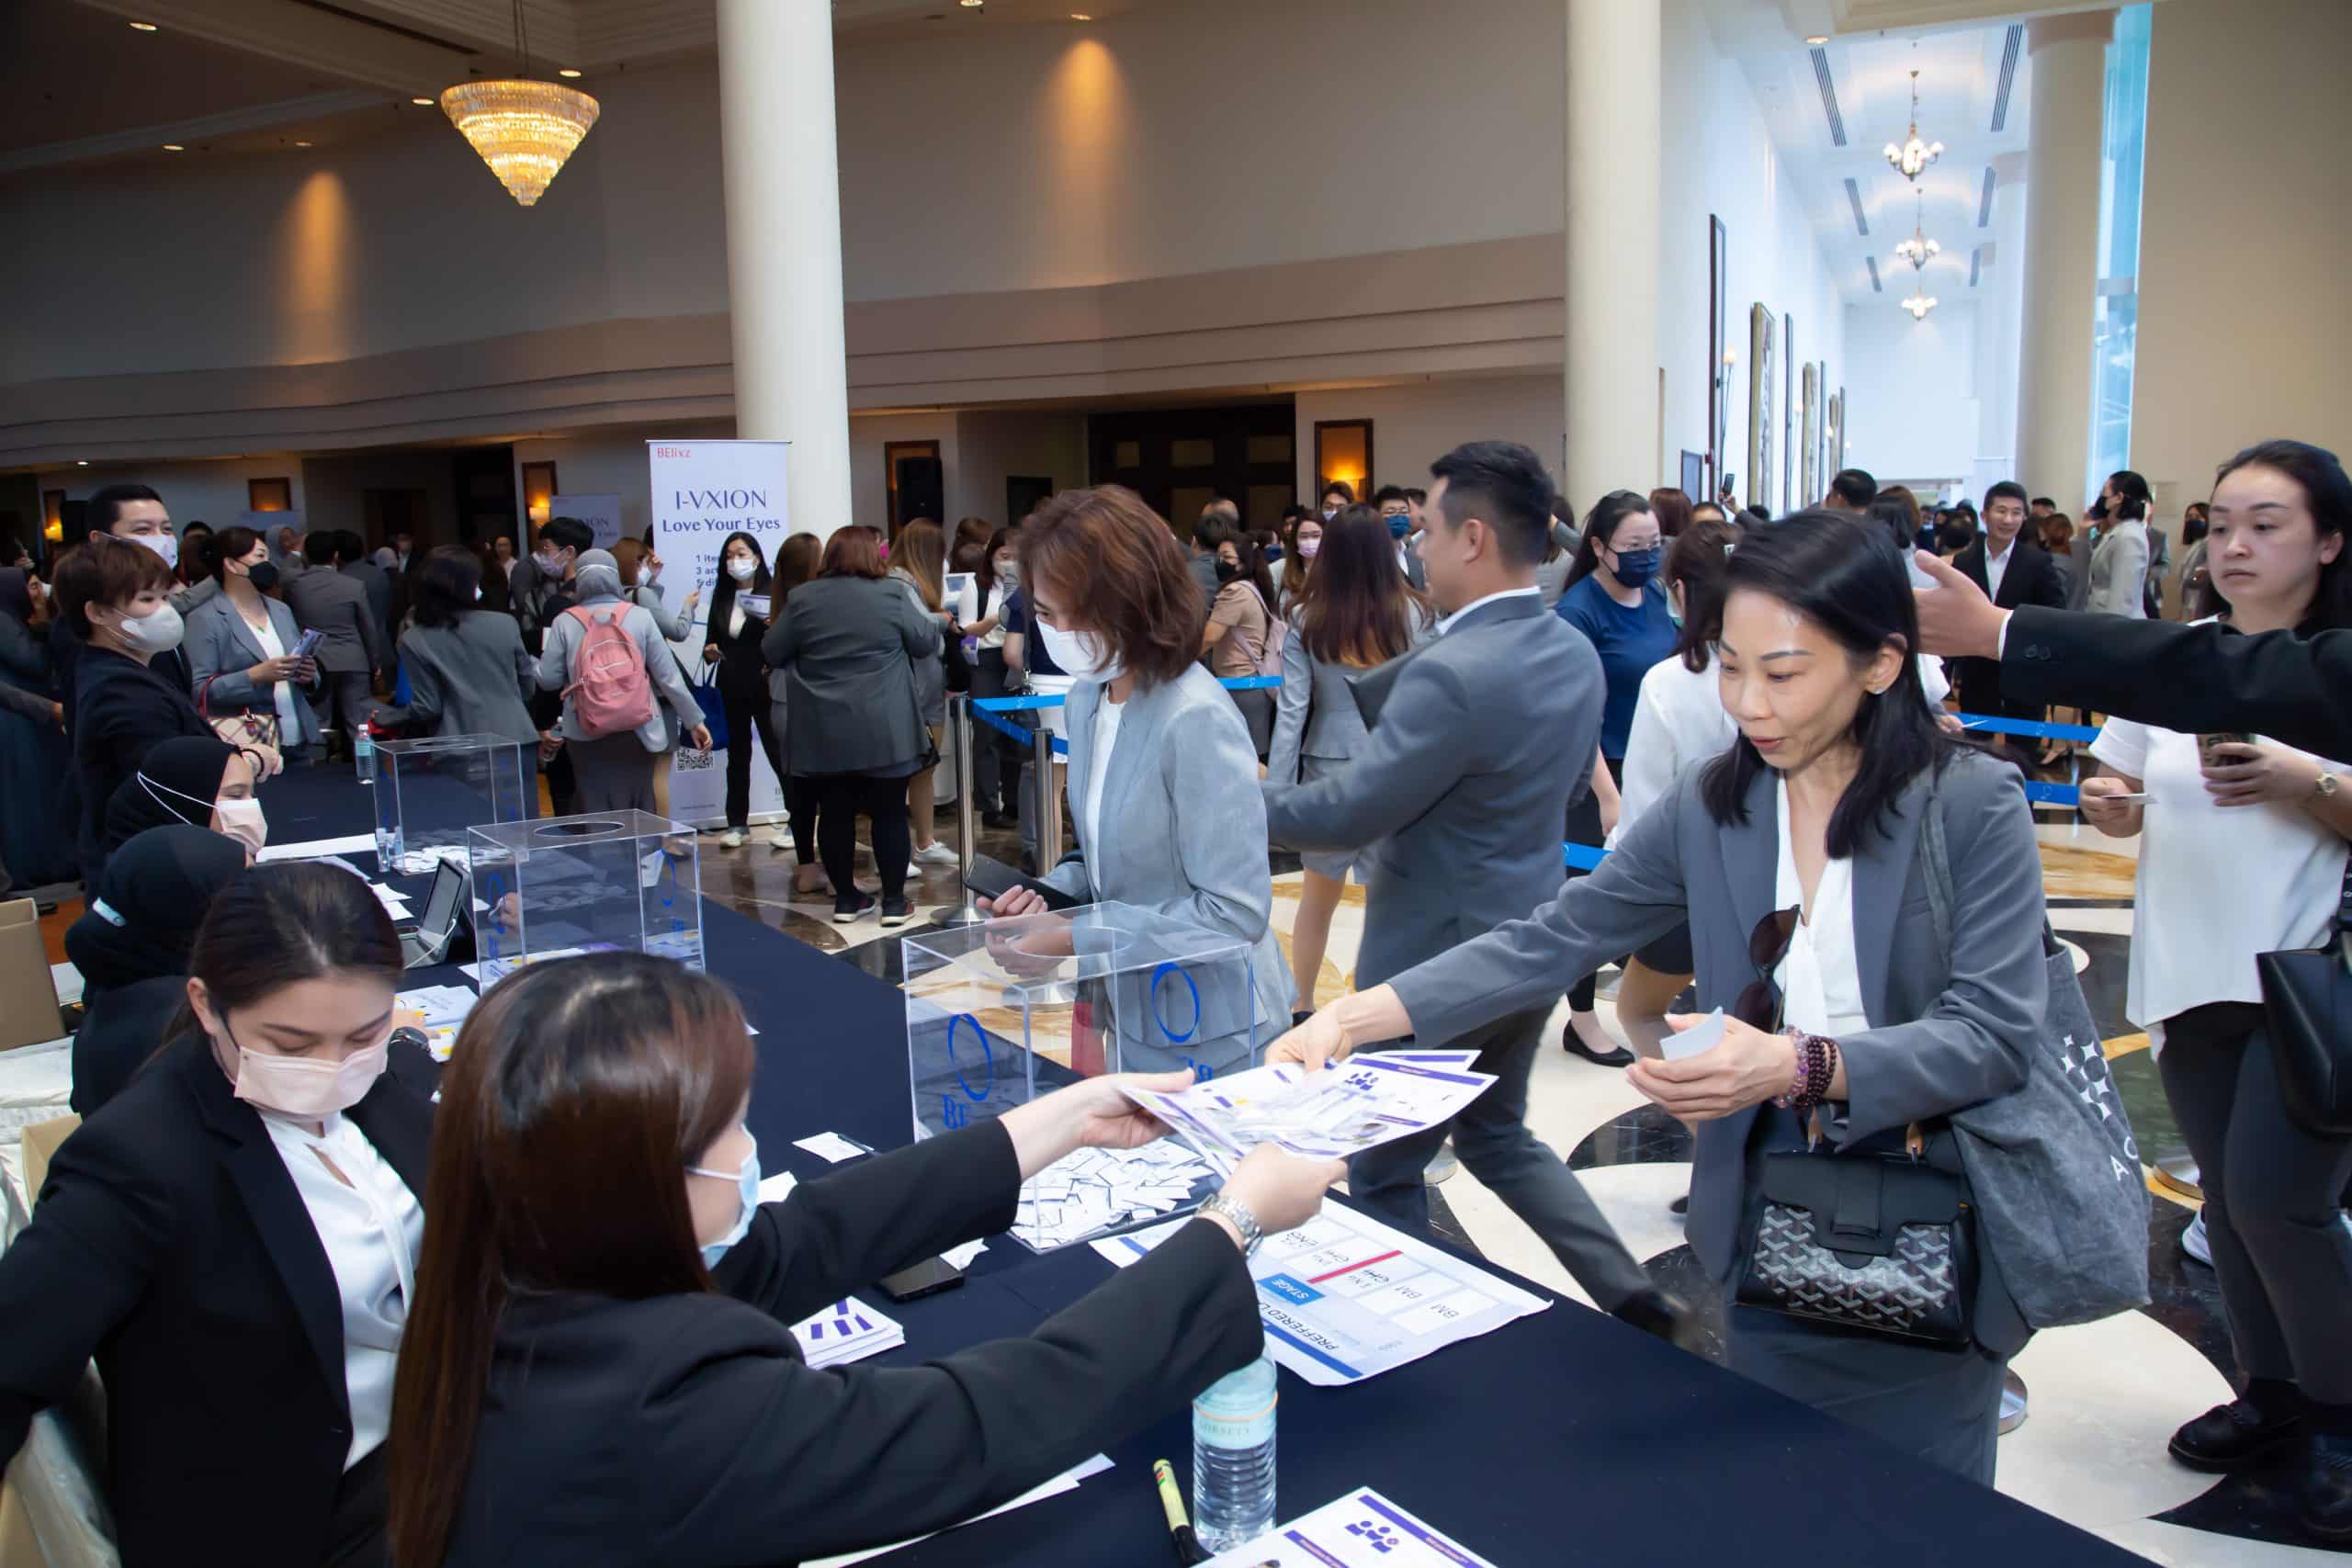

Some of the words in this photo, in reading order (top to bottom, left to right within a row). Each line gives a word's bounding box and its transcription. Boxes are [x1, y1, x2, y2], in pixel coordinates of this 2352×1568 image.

[676, 490, 767, 510] I-VXION
[662, 519, 701, 532] Love
[705, 518, 741, 531] Your
[747, 517, 780, 532] Eyes
[1272, 1279, 1309, 1300] STAGE
[1267, 1308, 1339, 1350] PREFFERED
